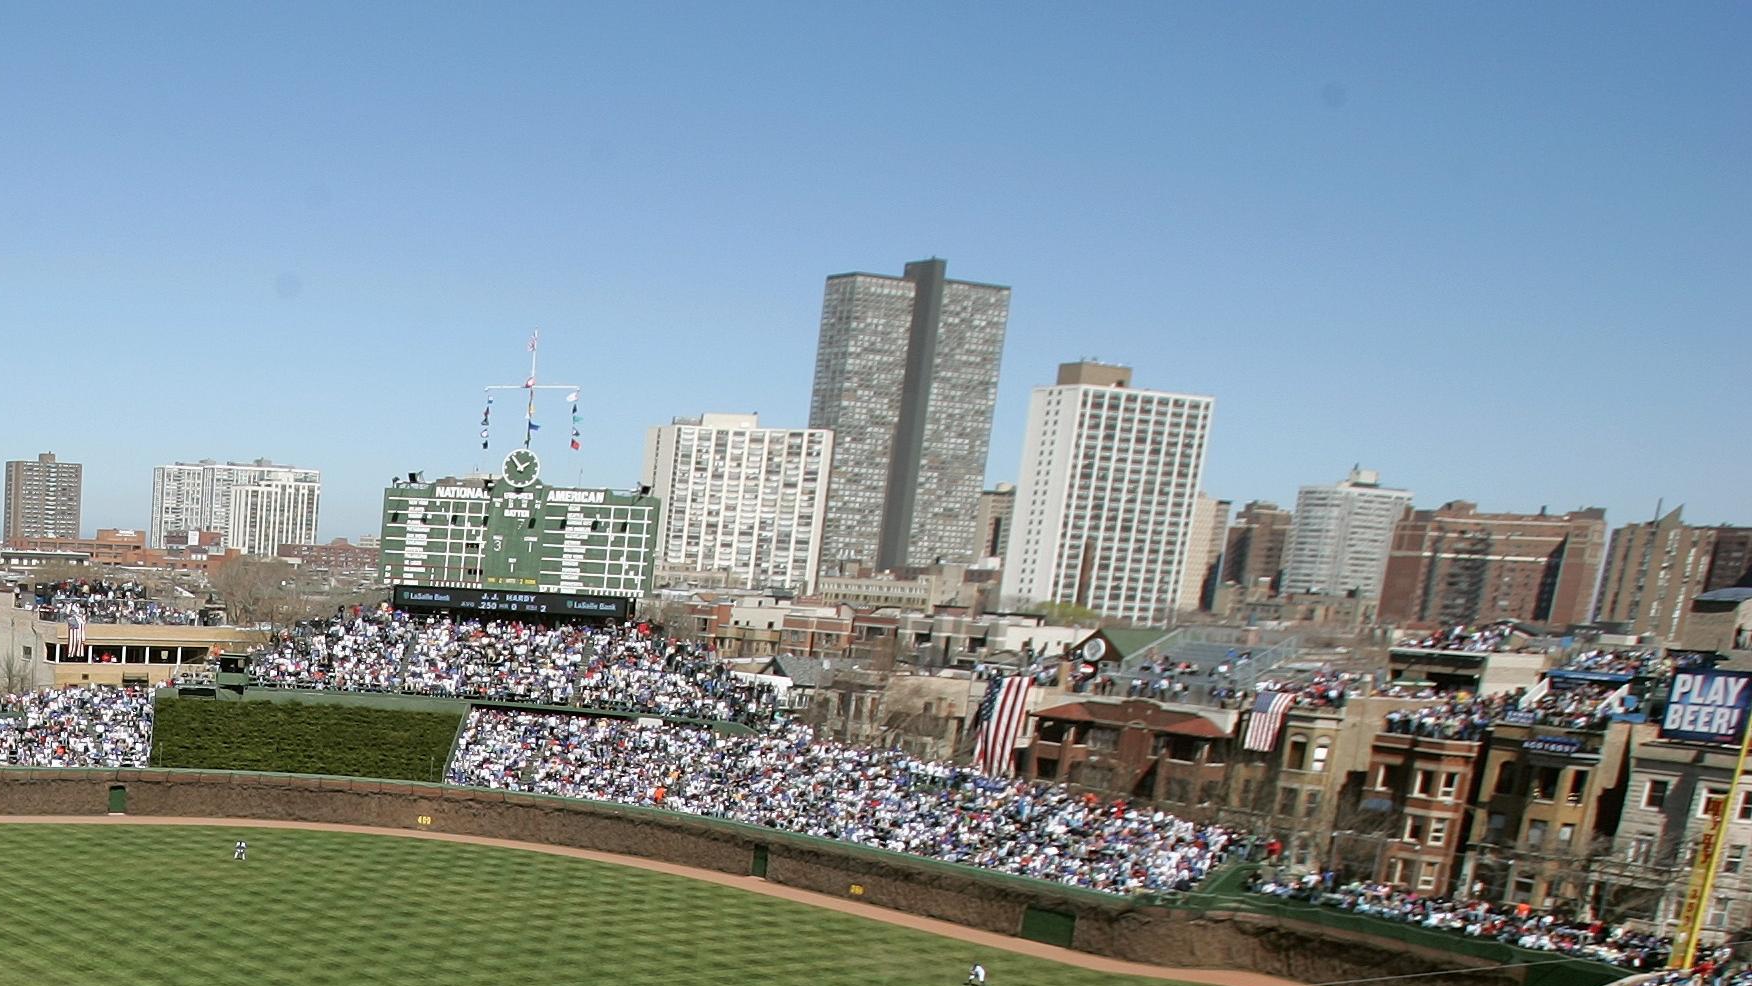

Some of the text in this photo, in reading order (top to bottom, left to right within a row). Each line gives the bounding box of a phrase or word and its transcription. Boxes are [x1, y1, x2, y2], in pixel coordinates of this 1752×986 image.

[436, 486, 490, 499] NATIONAL
[547, 490, 605, 503] AMERICAN
[493, 540, 502, 552] 3
[506, 594, 536, 602] HARDY
[1670, 673, 1749, 707] PLAY
[1663, 703, 1741, 735] BEER!
